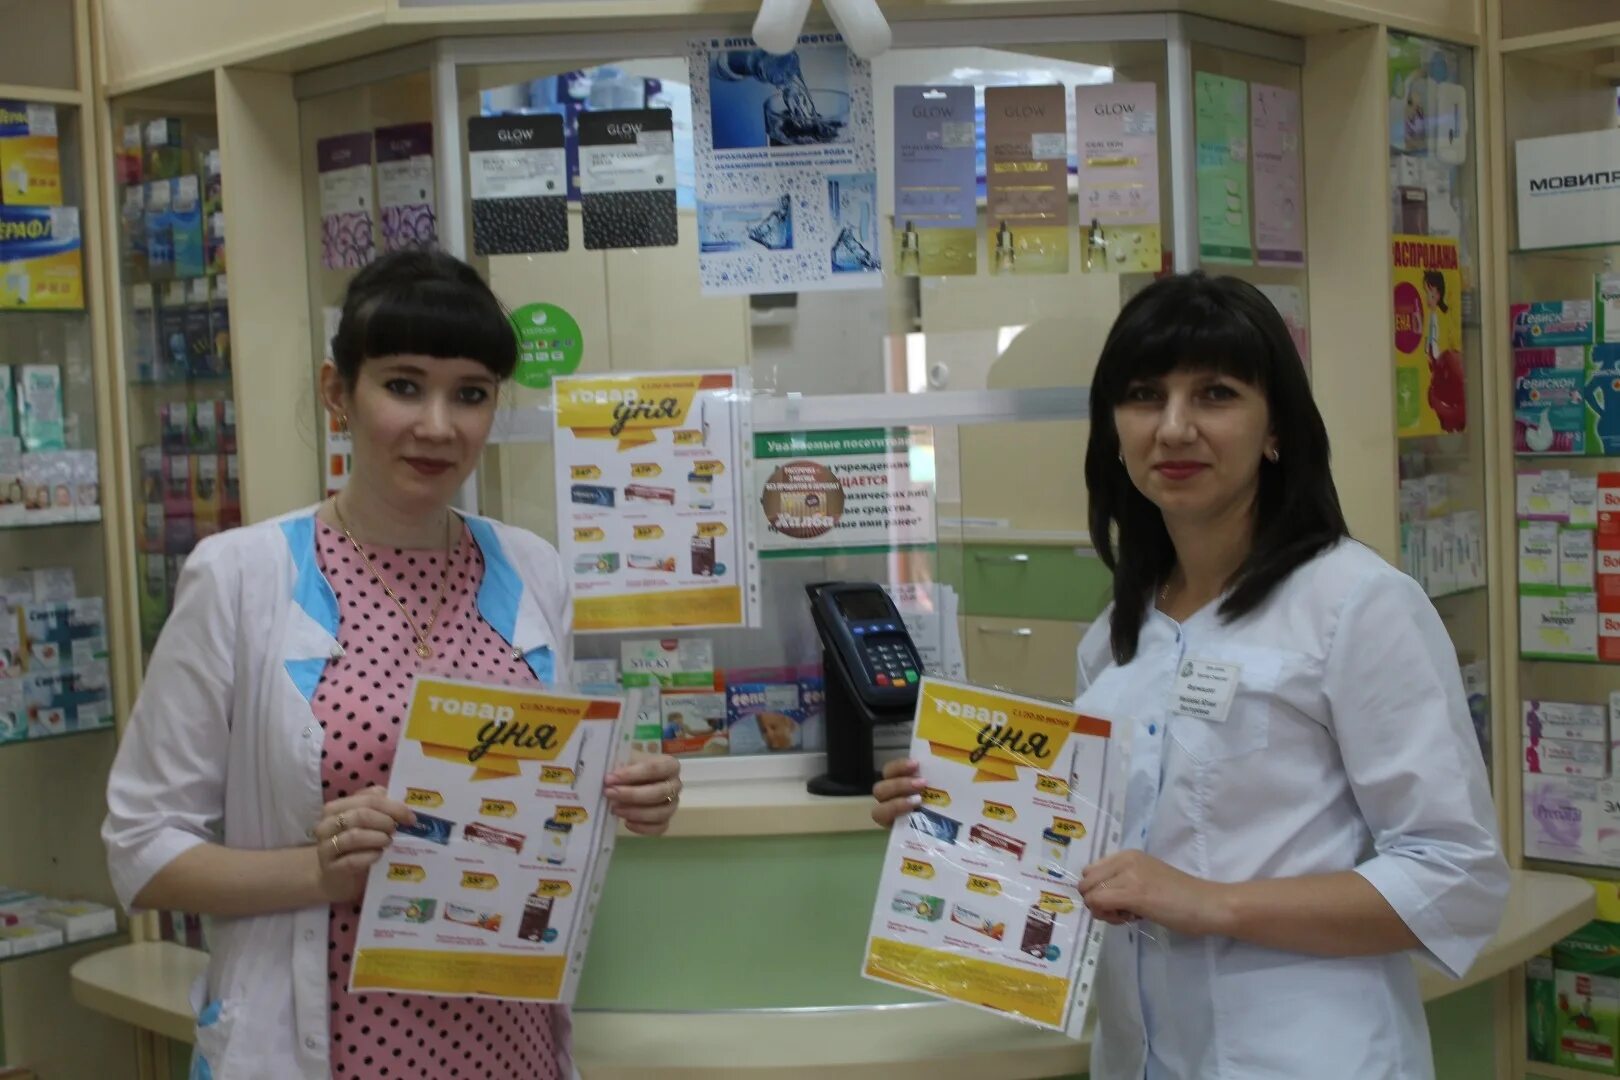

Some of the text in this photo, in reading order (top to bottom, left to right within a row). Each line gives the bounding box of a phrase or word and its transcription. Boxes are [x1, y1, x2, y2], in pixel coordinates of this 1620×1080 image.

[912, 105, 953, 119] GLOW
[1004, 104, 1044, 118] GLOW
[1094, 103, 1135, 116] GLOW
[497, 128, 534, 143] GLOW
[606, 122, 643, 137] GLOW
[1393, 241, 1459, 270] АСПРОДАЖА
[610, 396, 681, 437] дня
[841, 473, 888, 489] ЩАЕТСЯ
[844, 489, 905, 501] изических
[427, 695, 516, 726] товар
[934, 696, 1009, 731] товар
[468, 717, 560, 763] дня
[969, 722, 1052, 764] дня
